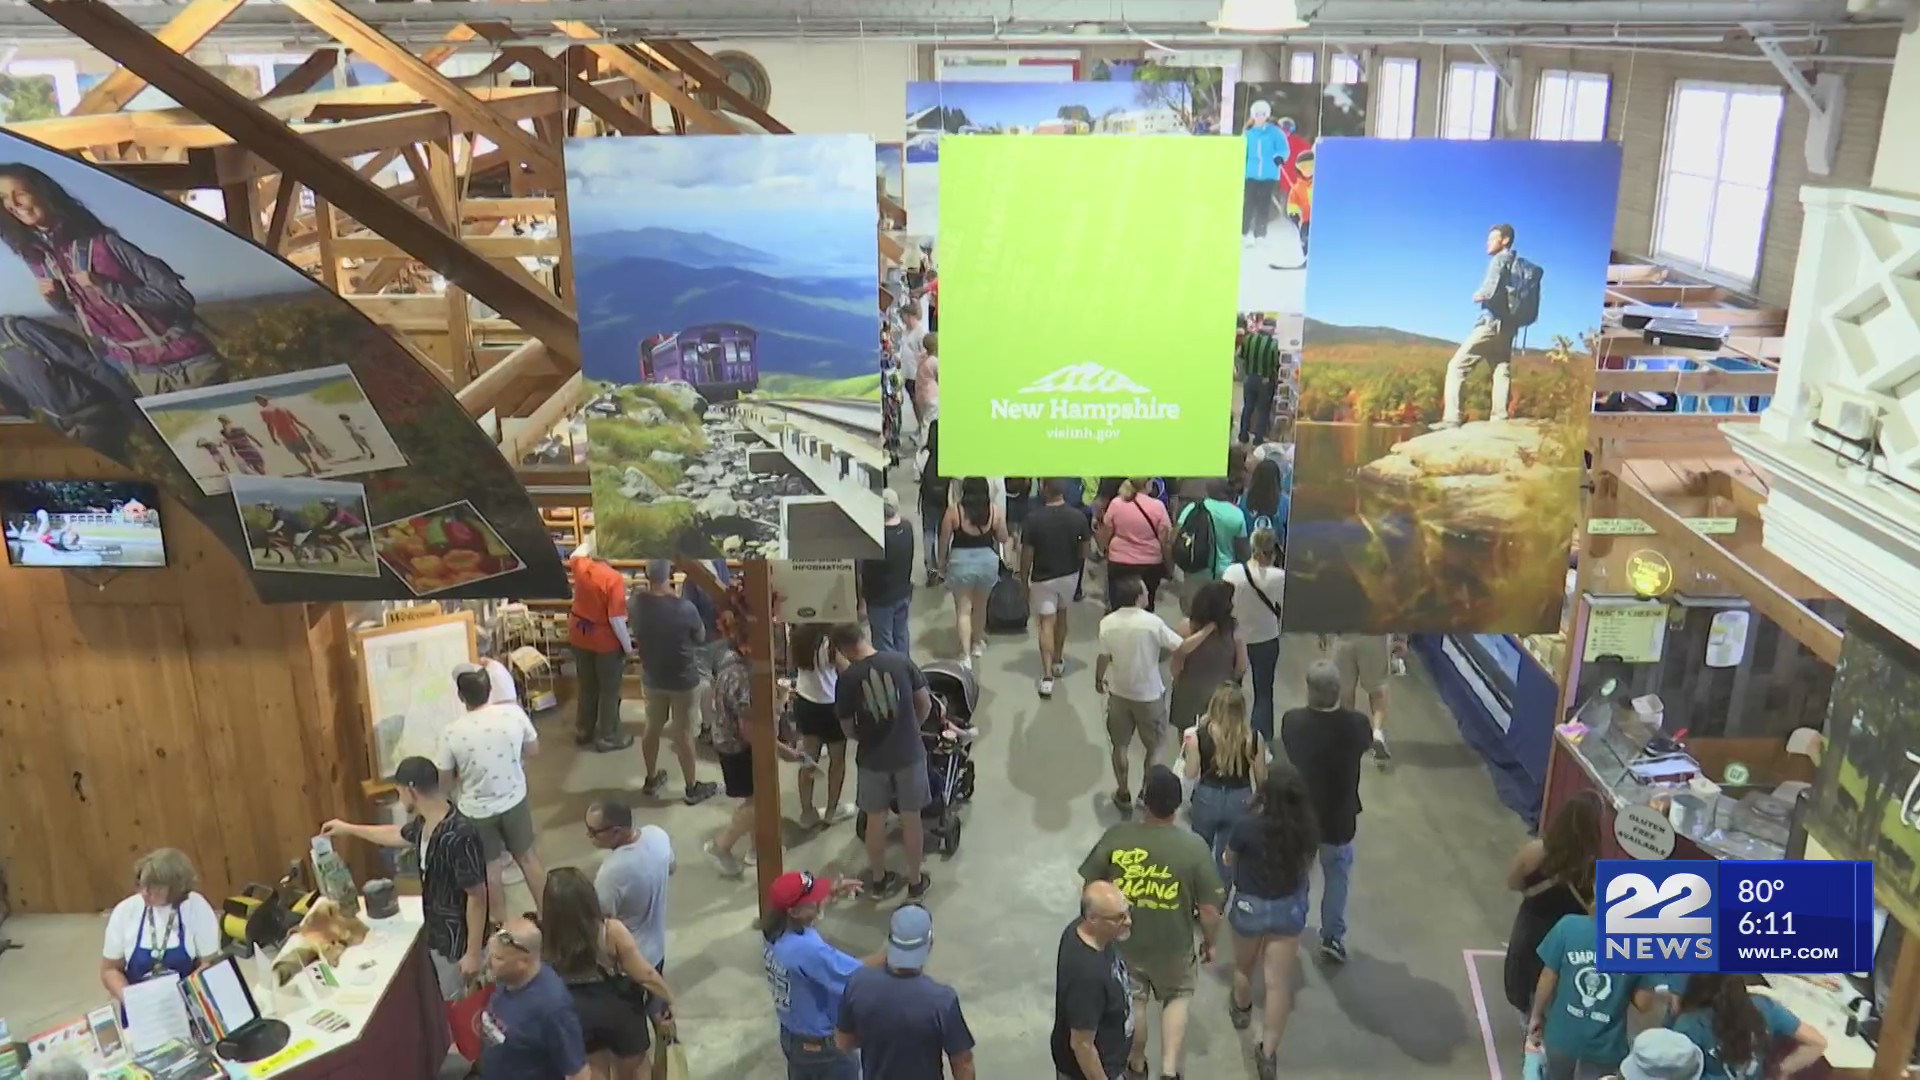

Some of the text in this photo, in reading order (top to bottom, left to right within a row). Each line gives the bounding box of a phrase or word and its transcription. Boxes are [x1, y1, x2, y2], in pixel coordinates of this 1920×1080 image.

[991, 397, 1181, 425] New Hampshire
[1628, 813, 1666, 835] GLUTEN
[1632, 826, 1656, 841] FREE
[1618, 830, 1666, 856] AVAILABLE
[1111, 847, 1149, 870] RED
[1123, 864, 1173, 879] BULL
